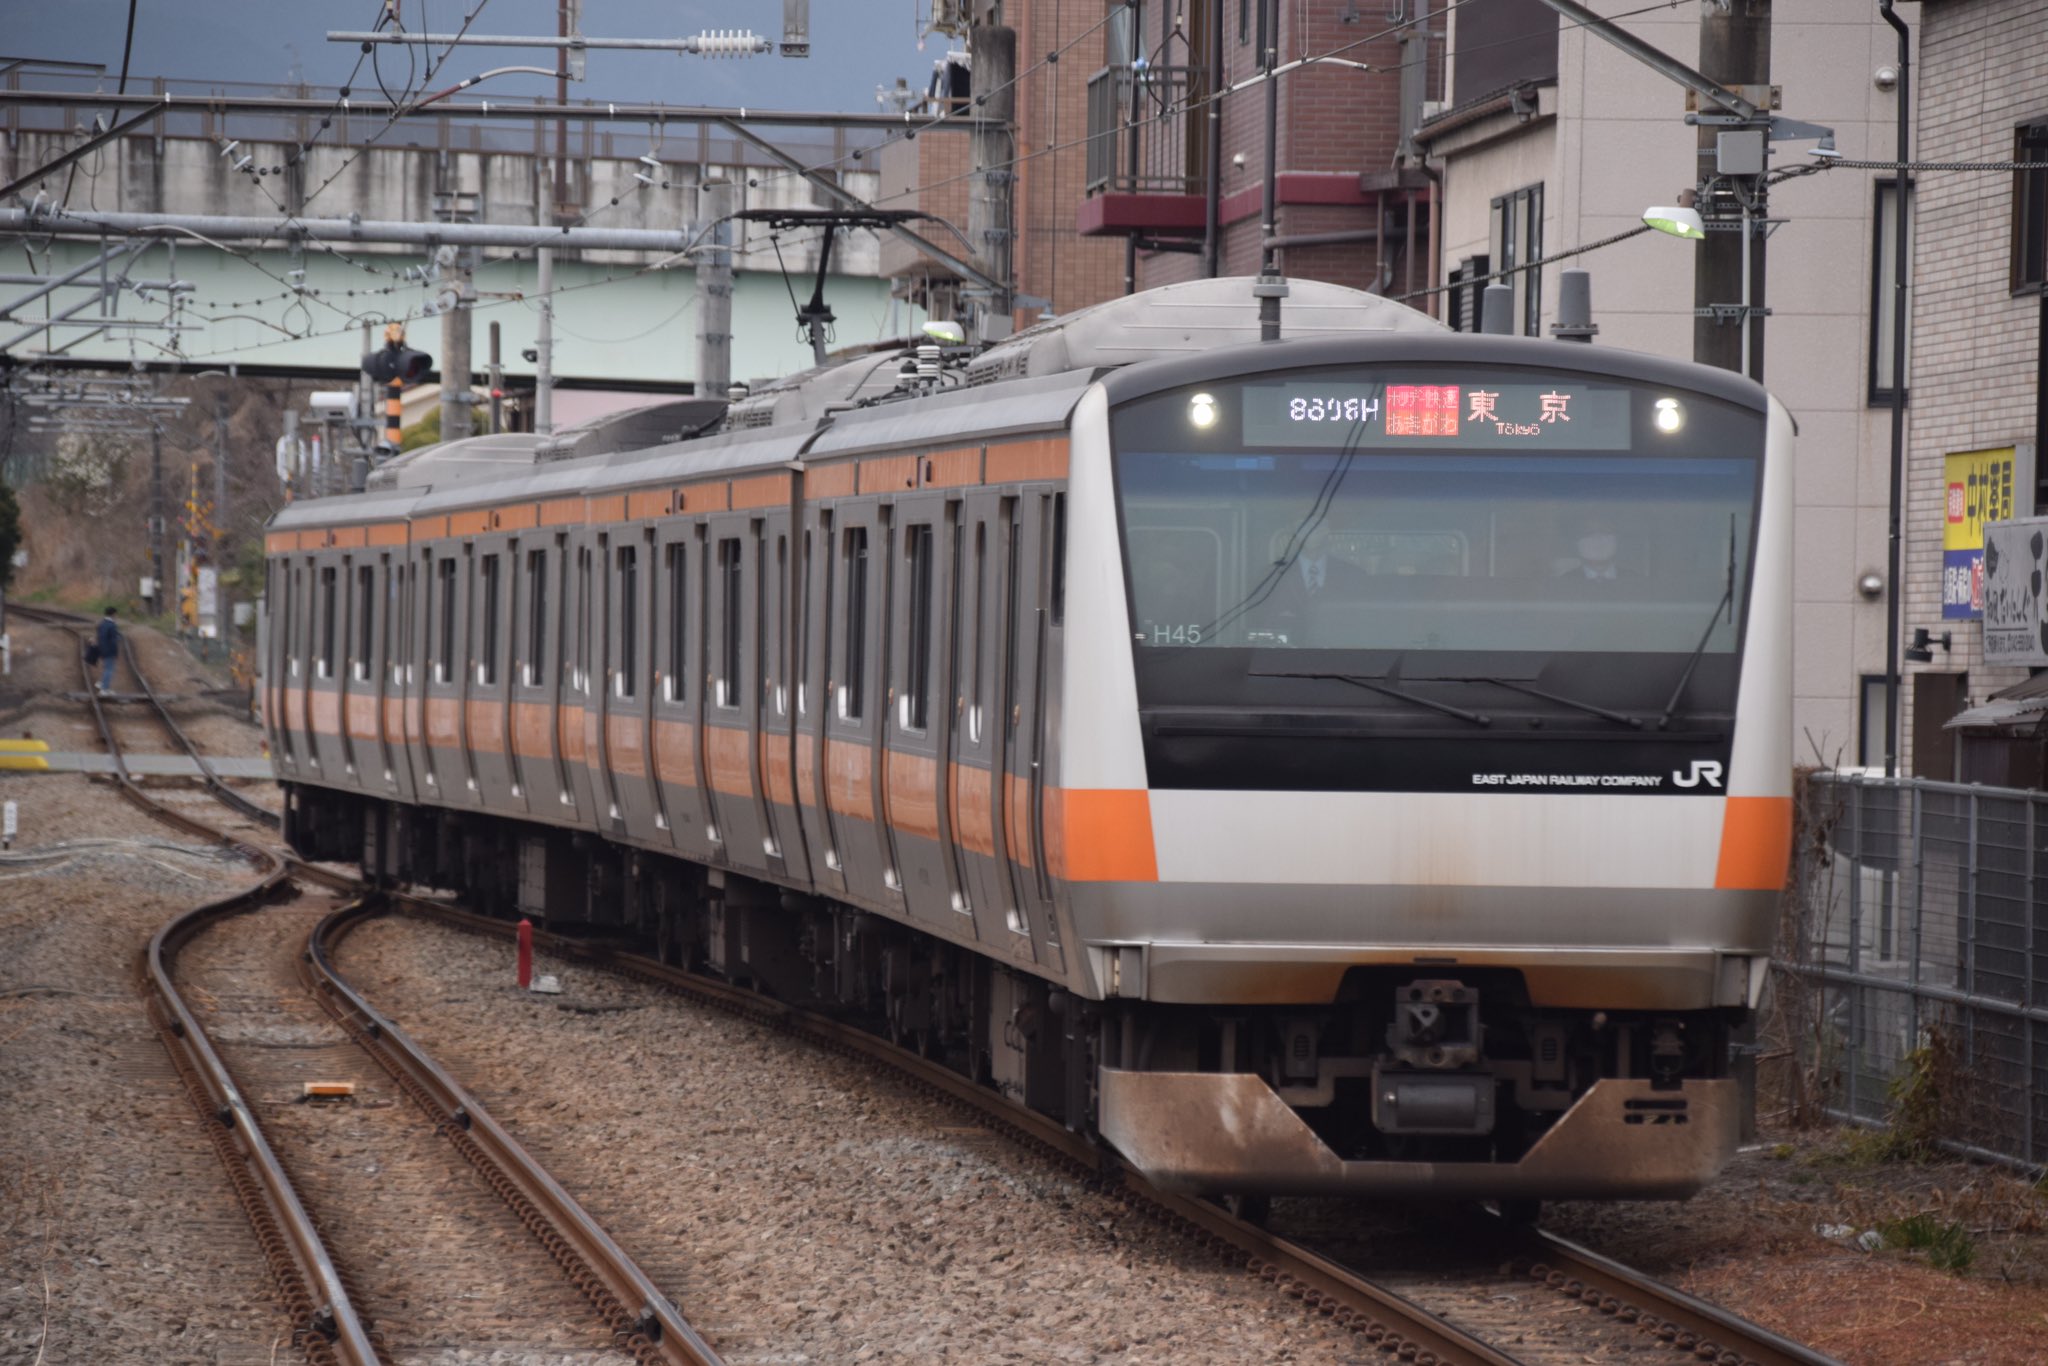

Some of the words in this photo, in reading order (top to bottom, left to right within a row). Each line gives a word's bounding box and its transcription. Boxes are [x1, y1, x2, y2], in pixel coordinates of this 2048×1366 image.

[1468, 390, 1571, 423] 東京
[1153, 624, 1201, 643] H45
[1472, 774, 1506, 785] EAST
[1506, 774, 1548, 785] JAPAN
[1549, 775, 1600, 786] RAILWAY
[1600, 776, 1662, 786] COMPANY
[1672, 760, 1723, 787] JR
